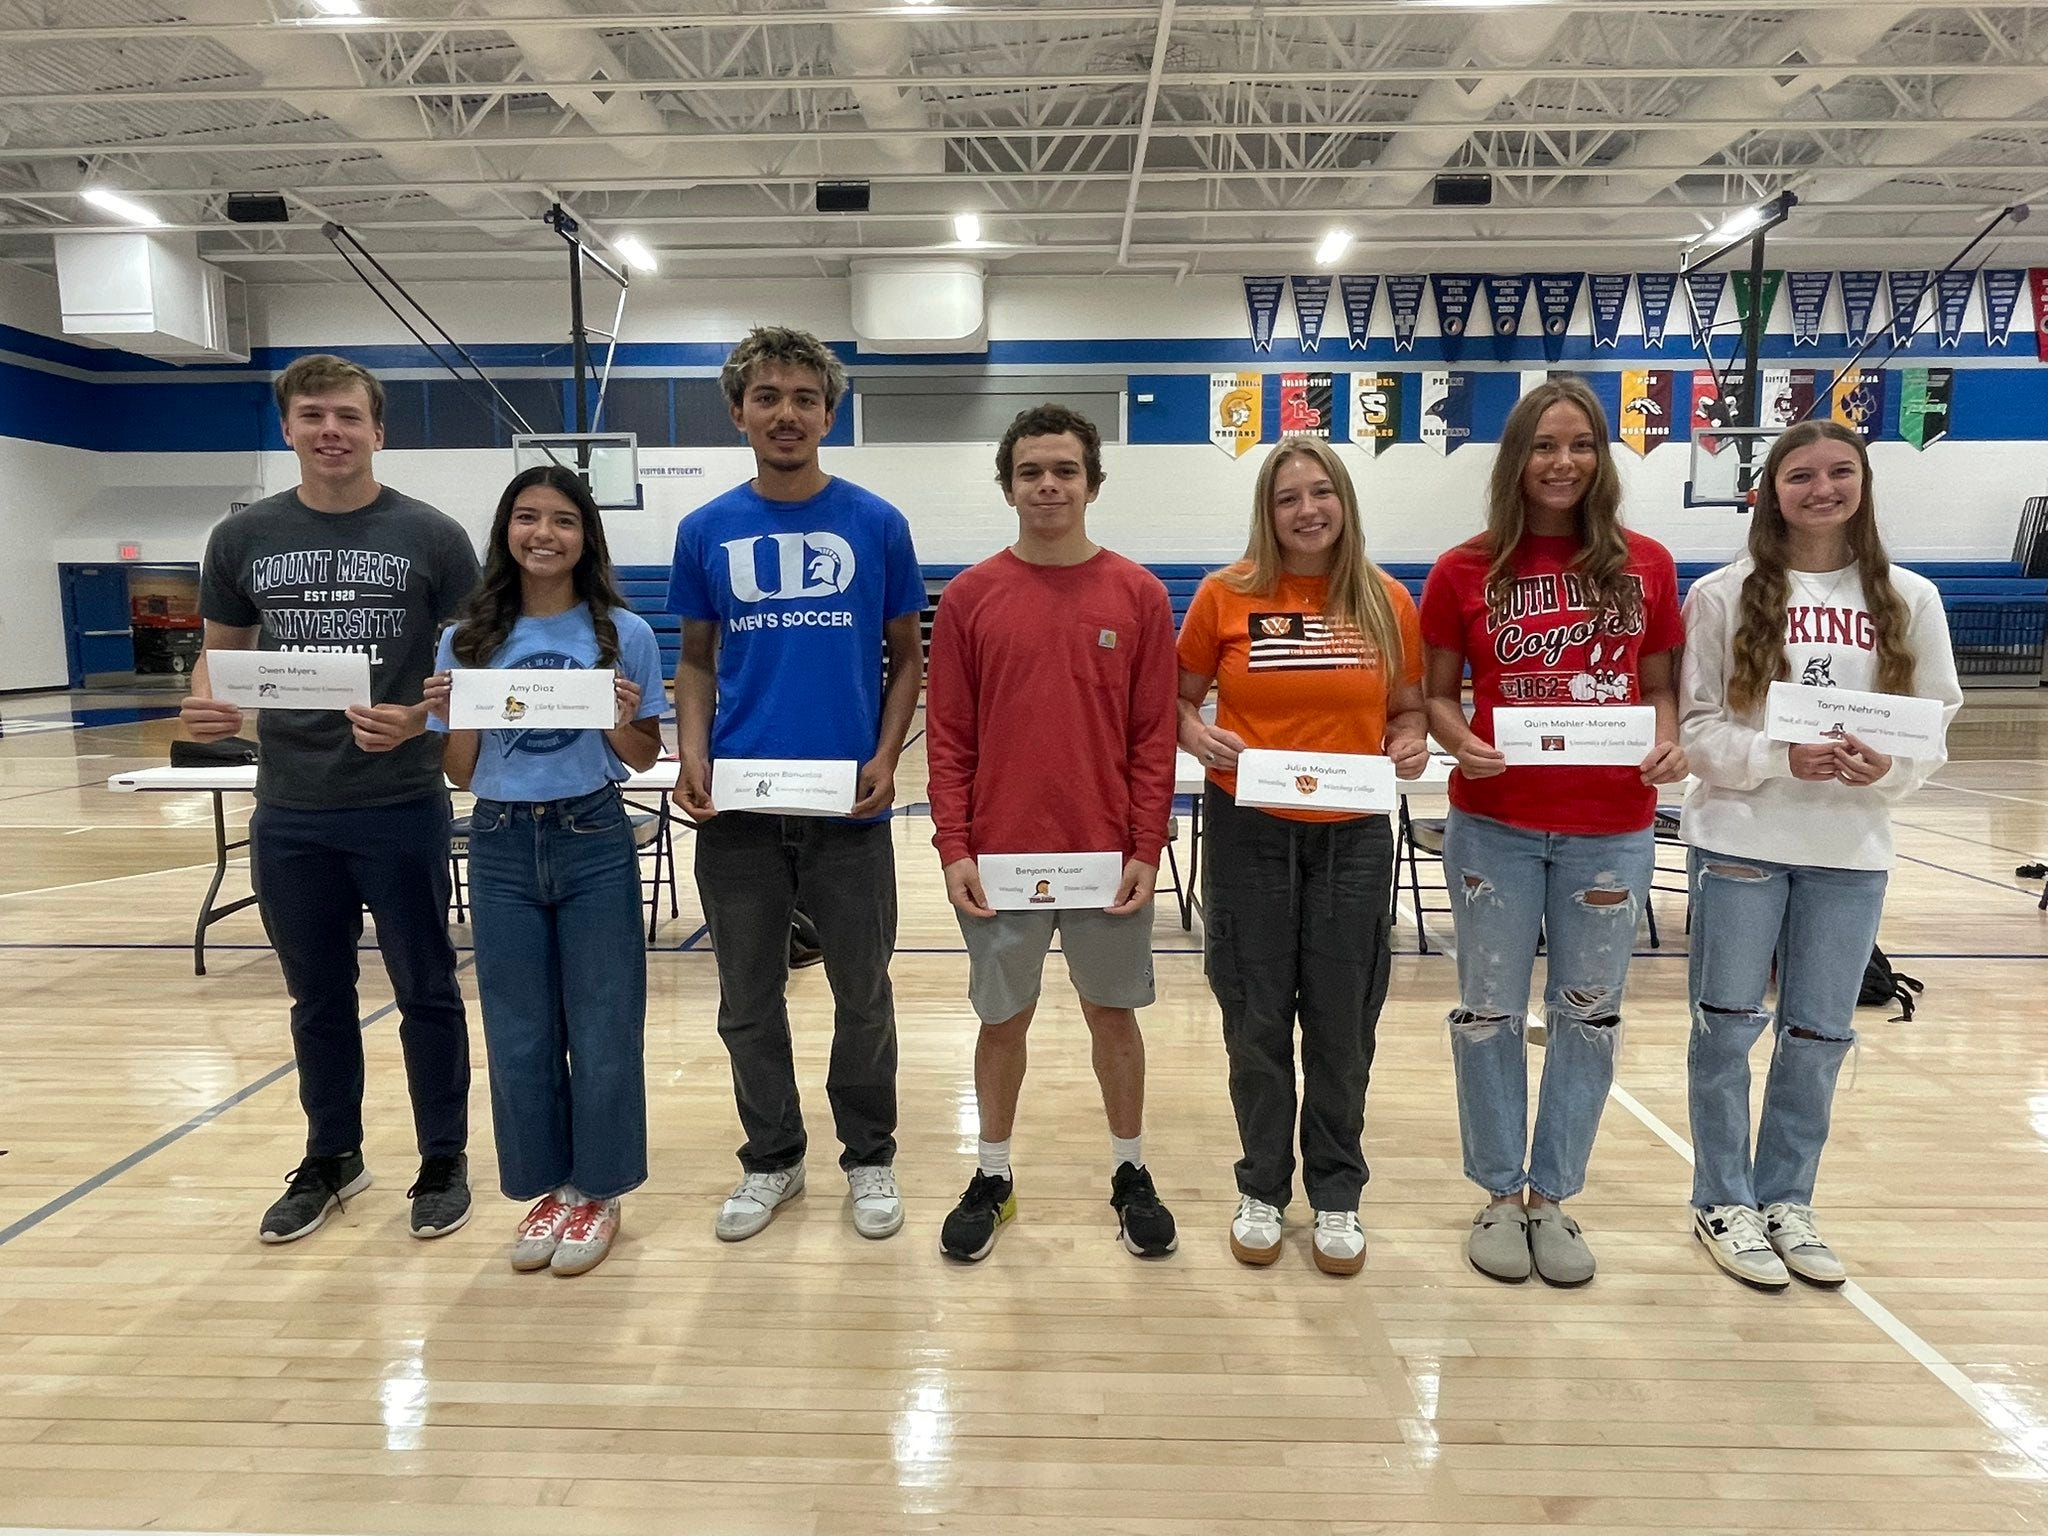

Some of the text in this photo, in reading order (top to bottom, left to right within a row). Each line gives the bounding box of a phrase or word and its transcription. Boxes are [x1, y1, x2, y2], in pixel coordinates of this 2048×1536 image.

[668, 467, 703, 475] STUDENTS
[252, 550, 410, 593] MOUNT MERCY
[304, 589, 356, 601] EST 1928
[730, 611, 853, 633] MEN'S SOCCER
[1786, 606, 1877, 652] KING
[258, 666, 317, 676] Owen Myers
[509, 684, 555, 694] Amy Diaz
[1515, 676, 1560, 699] 1862
[1817, 700, 1891, 718] Taryn Nehring
[1524, 719, 1626, 729] Quin Mahler-Moreno
[1285, 763, 1347, 775] Julie Maylum
[1015, 867, 1083, 876] Benjamin Kusar
